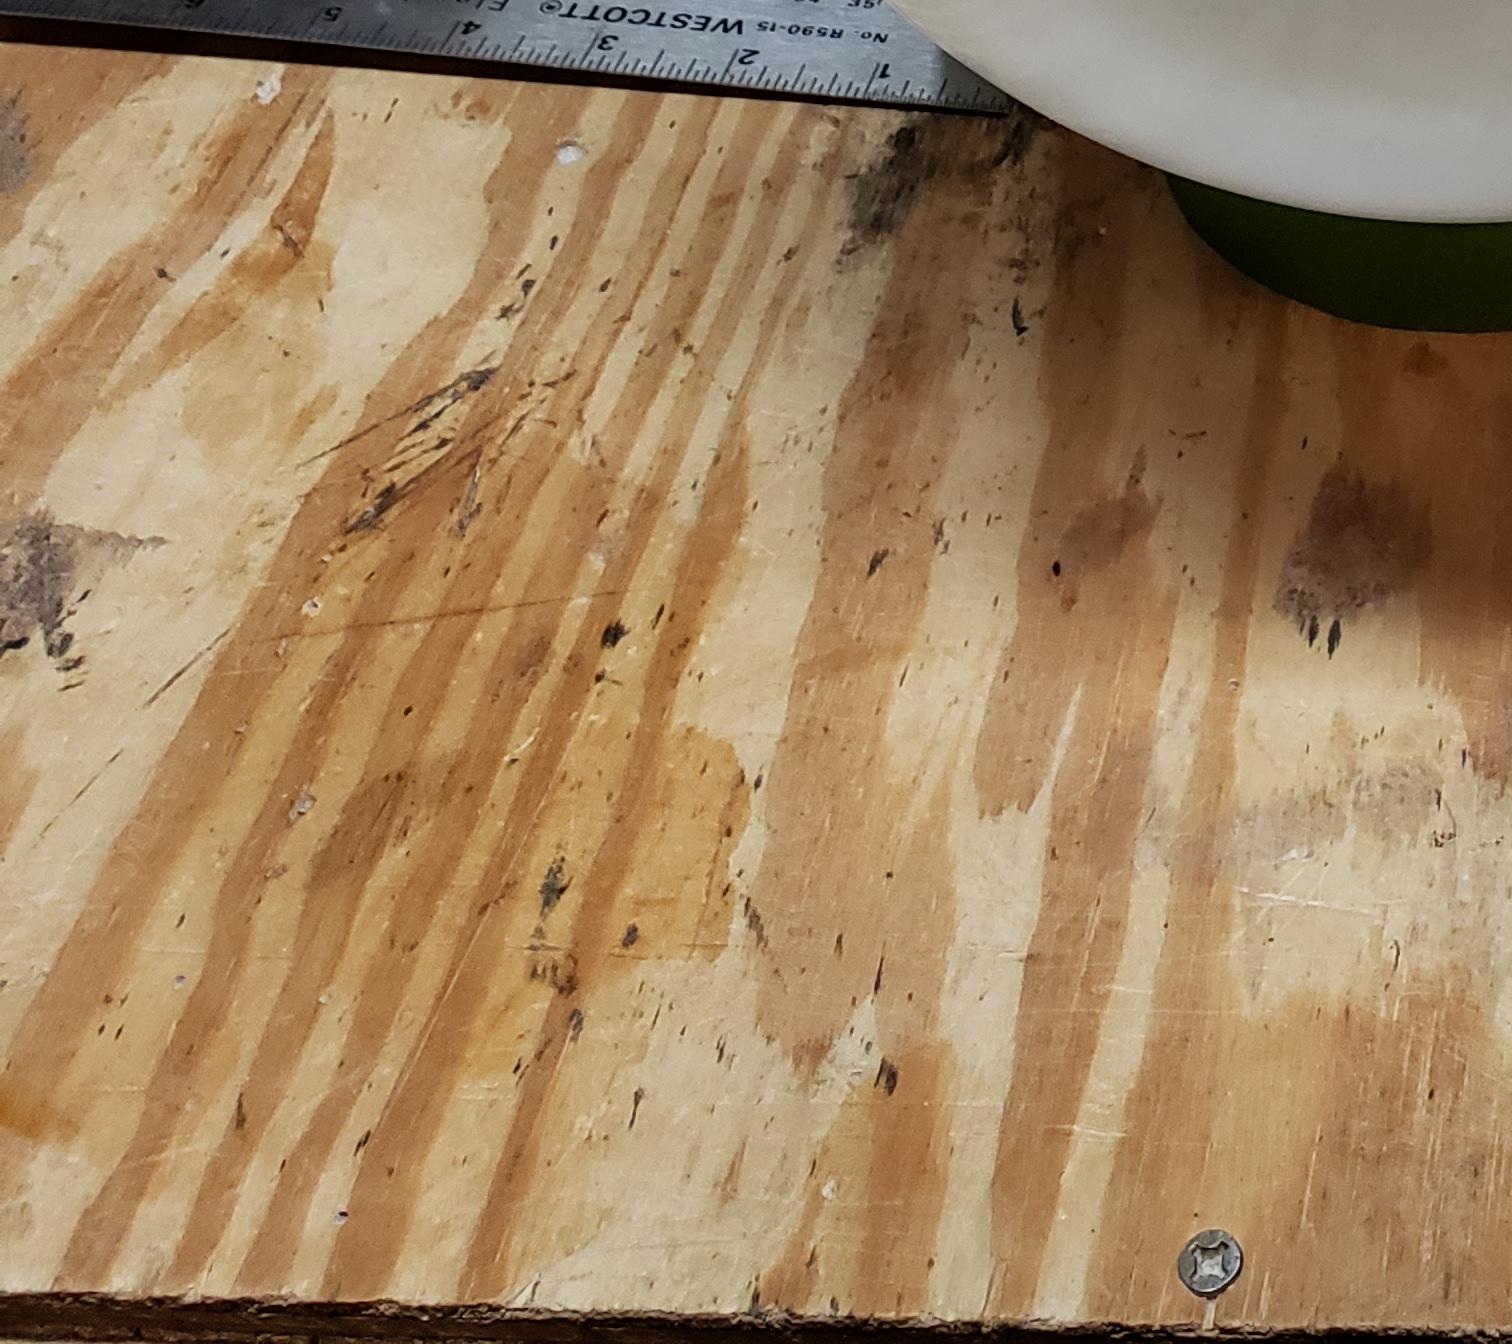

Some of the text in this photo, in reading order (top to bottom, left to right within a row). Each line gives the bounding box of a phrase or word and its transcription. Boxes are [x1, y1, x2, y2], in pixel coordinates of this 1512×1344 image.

[324, 6, 343, 22] 5
[461, 20, 482, 35] 4
[756, 20, 844, 40] R590-15
[597, 34, 620, 51] 3
[853, 29, 890, 44] No.
[738, 48, 761, 65] 2
[877, 62, 892, 79] 1
